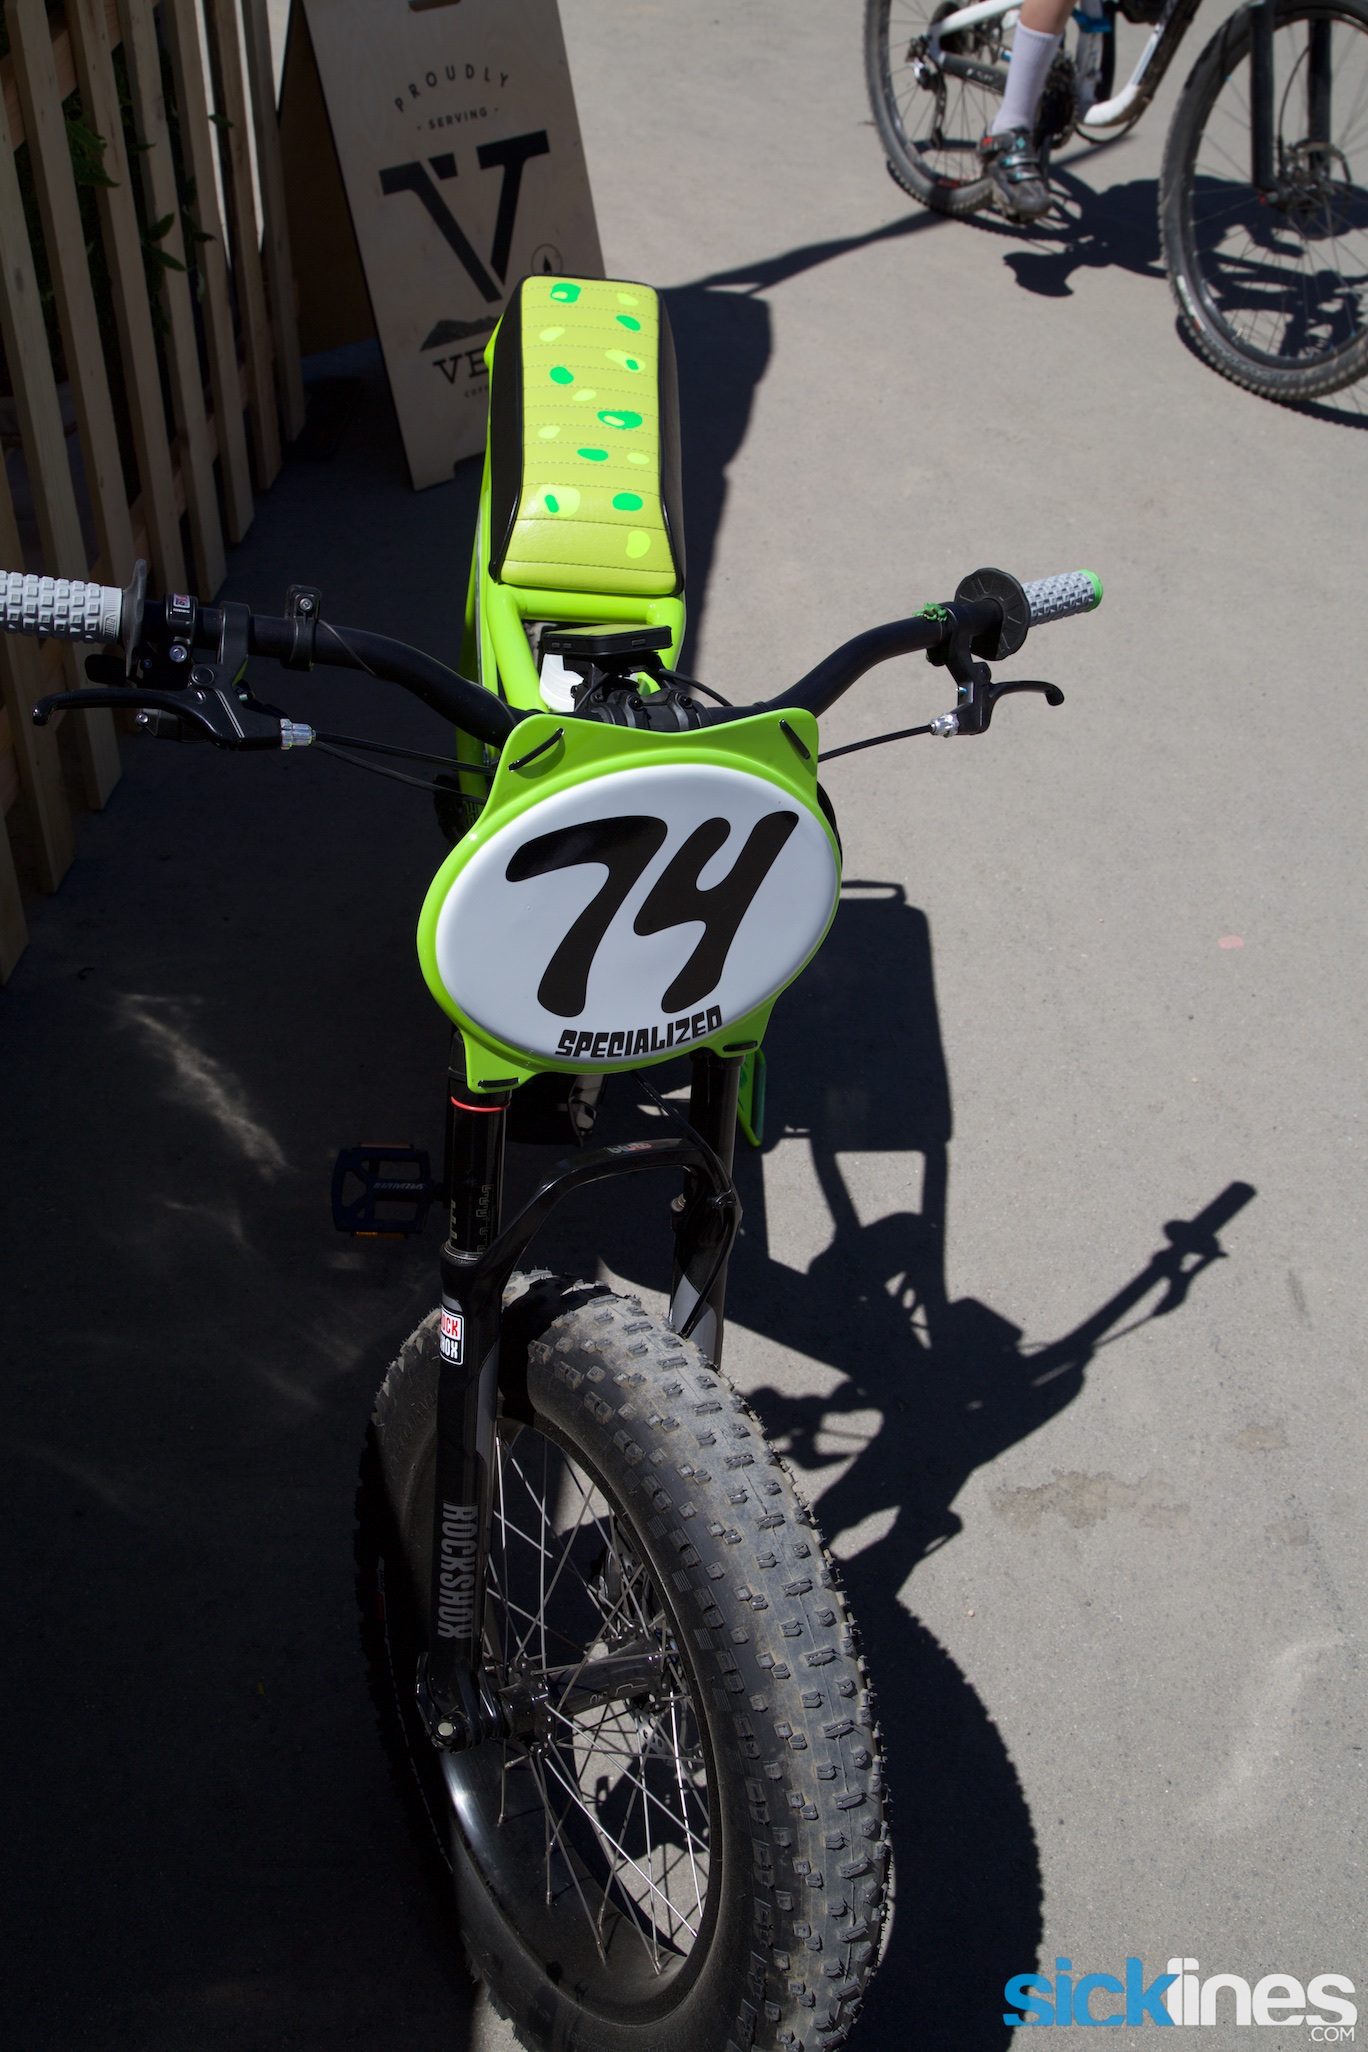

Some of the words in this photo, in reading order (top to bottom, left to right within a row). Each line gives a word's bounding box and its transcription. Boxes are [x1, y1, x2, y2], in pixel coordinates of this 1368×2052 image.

[394, 64, 508, 112] PROUDLY
[428, 106, 488, 129] SERVING
[432, 346, 488, 384] VE
[505, 810, 799, 1017] 74
[555, 1005, 723, 1058] SPECIALIZED
[440, 1313, 459, 1337] OCK
[437, 1502, 478, 1639] ROCKSHOX
